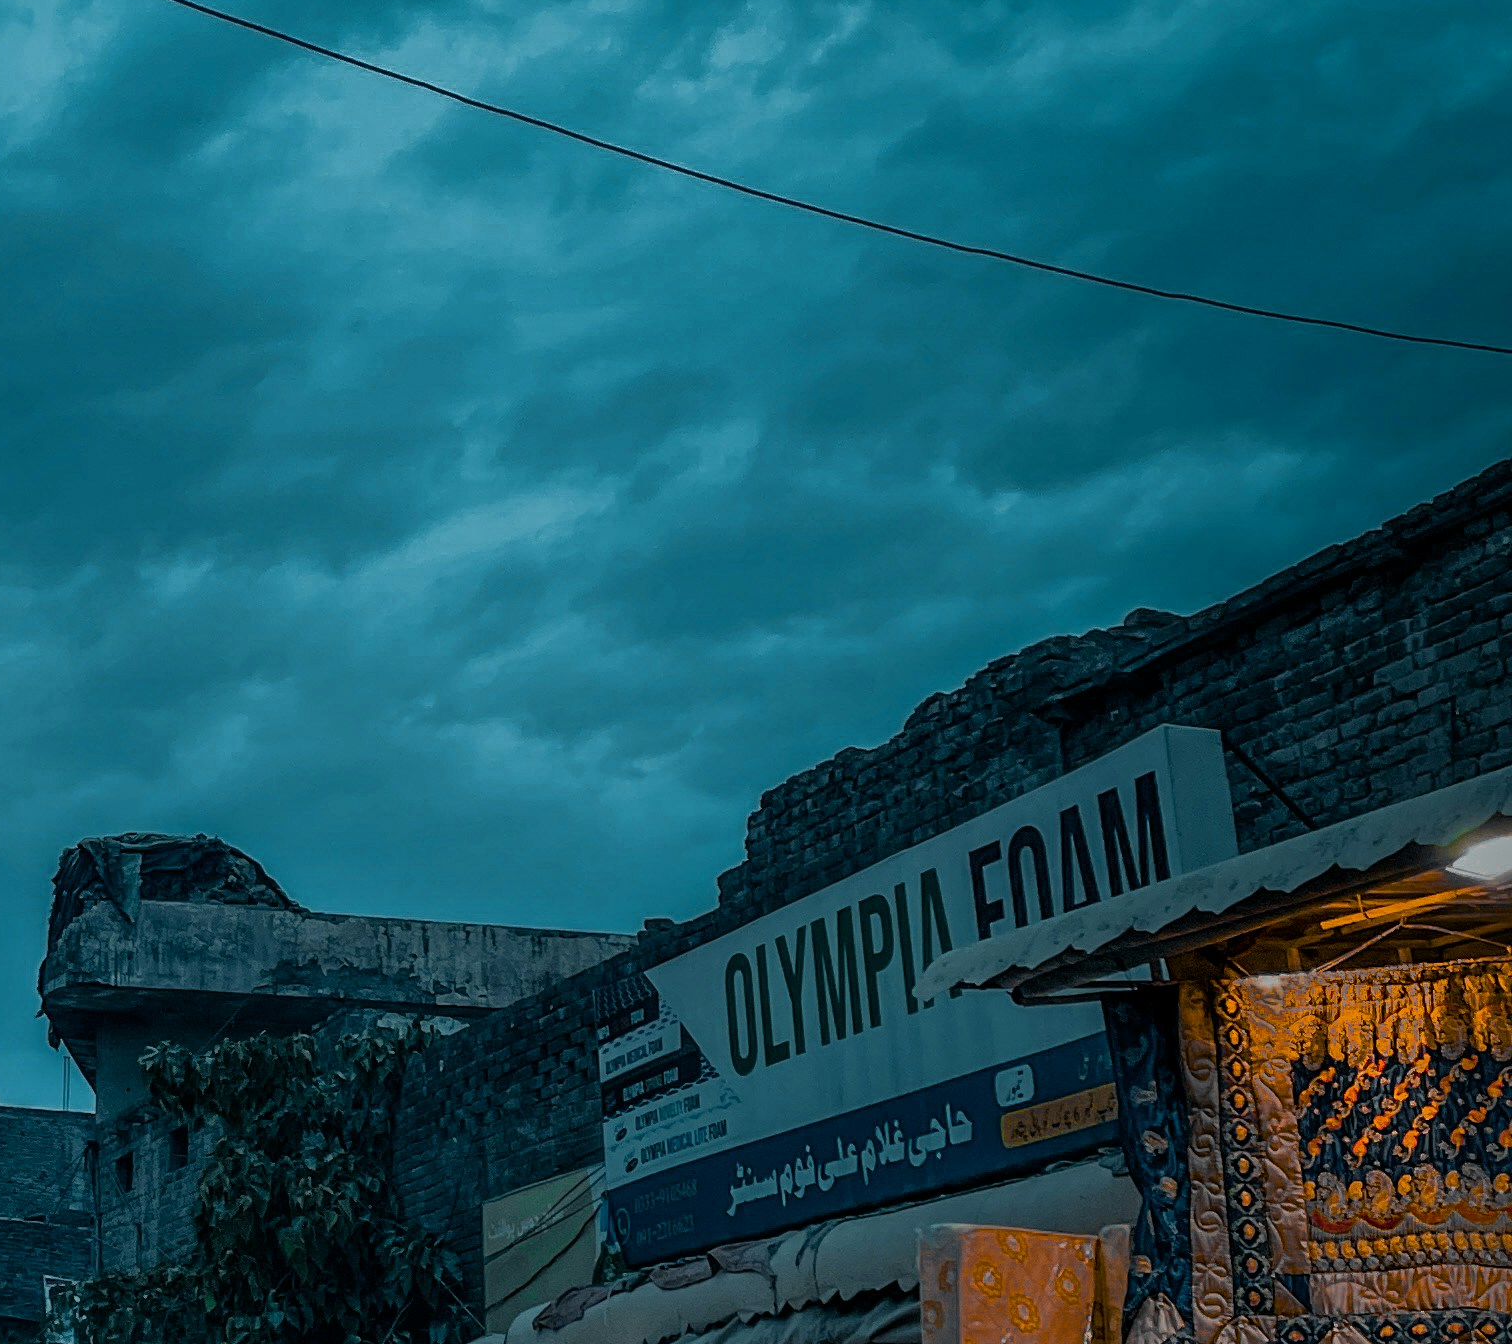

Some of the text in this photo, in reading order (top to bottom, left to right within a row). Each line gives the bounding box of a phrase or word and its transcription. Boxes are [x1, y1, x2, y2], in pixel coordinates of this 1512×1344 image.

[725, 771, 1171, 1076] OLYMPIA FOAM
[640, 1140, 666, 1165] OLYMPIA
[708, 1119, 728, 1139] FOAM
[816, 1136, 859, 1192] علی
[860, 1120, 905, 1186] غلام
[908, 1102, 973, 1167] حاجی
[726, 1160, 779, 1216] سنٹر
[780, 1144, 816, 1207] فوم
